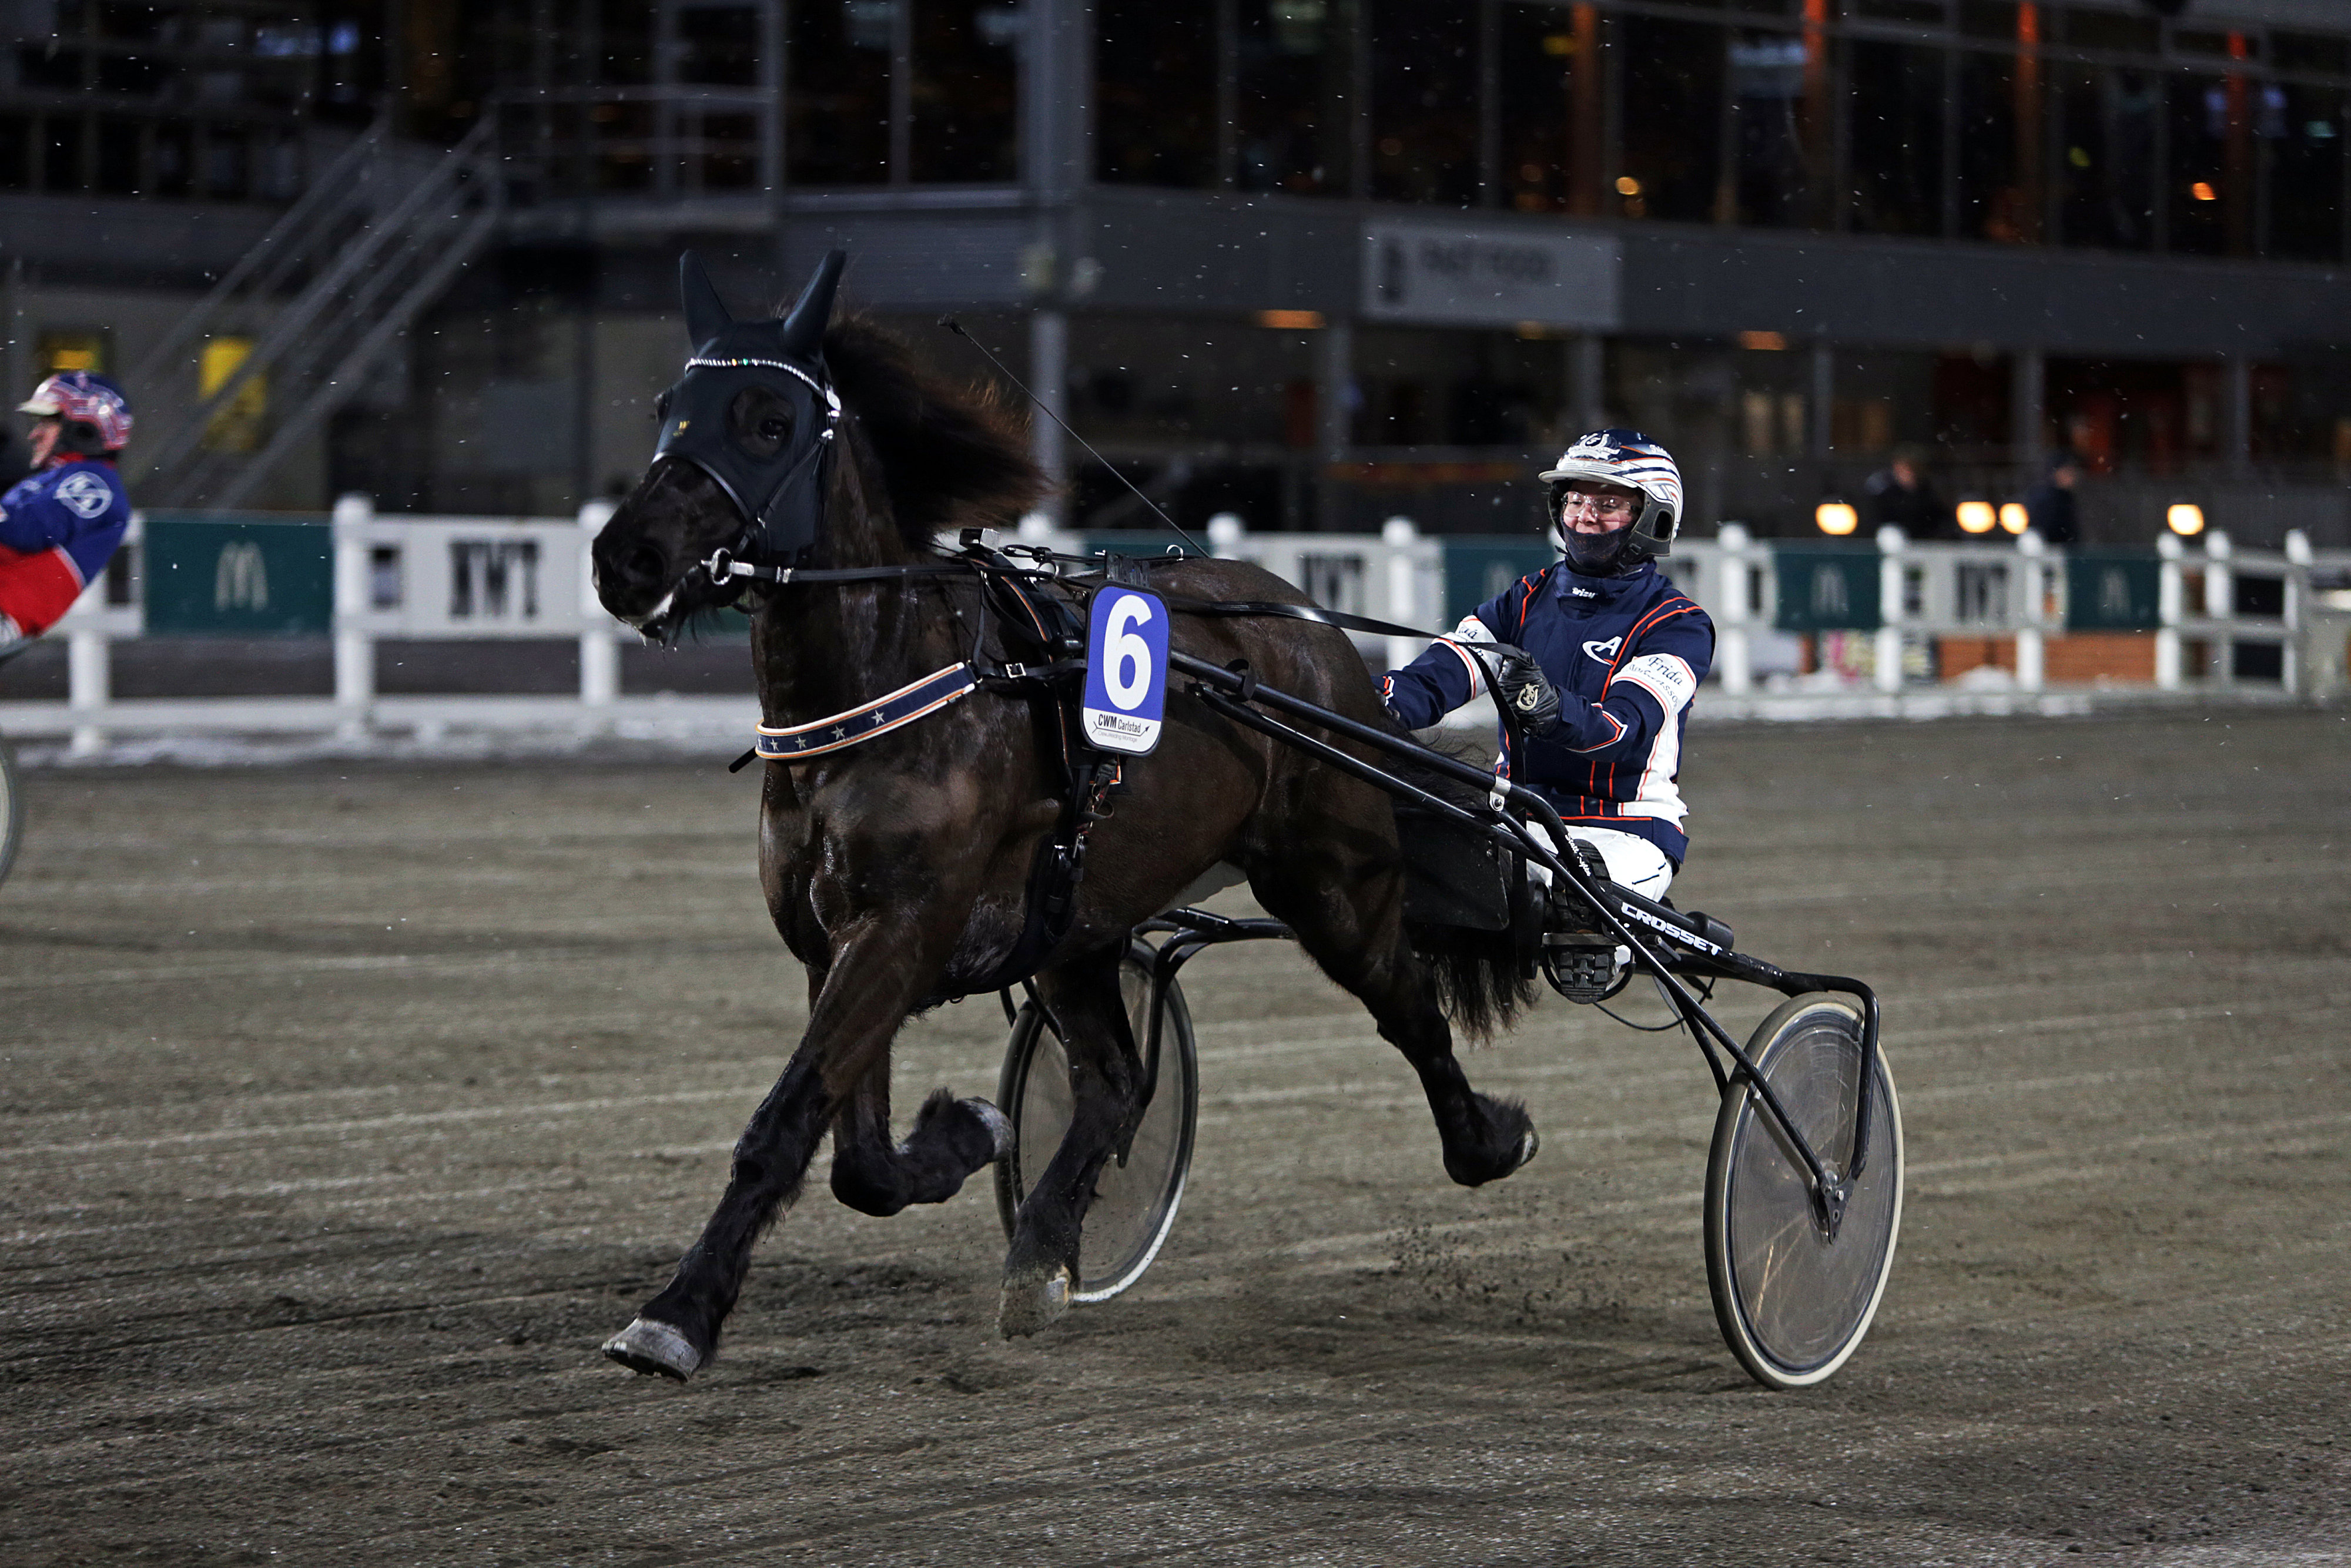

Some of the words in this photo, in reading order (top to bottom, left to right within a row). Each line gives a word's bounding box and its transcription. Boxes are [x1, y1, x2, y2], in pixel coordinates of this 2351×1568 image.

[1103, 594, 1152, 711] 6
[1647, 656, 1683, 686] Frida
[1098, 713, 1117, 729] CWM
[1118, 719, 1141, 733] Carlstad
[1122, 735, 1138, 743] Montage
[1620, 902, 1723, 956] CROSSET
